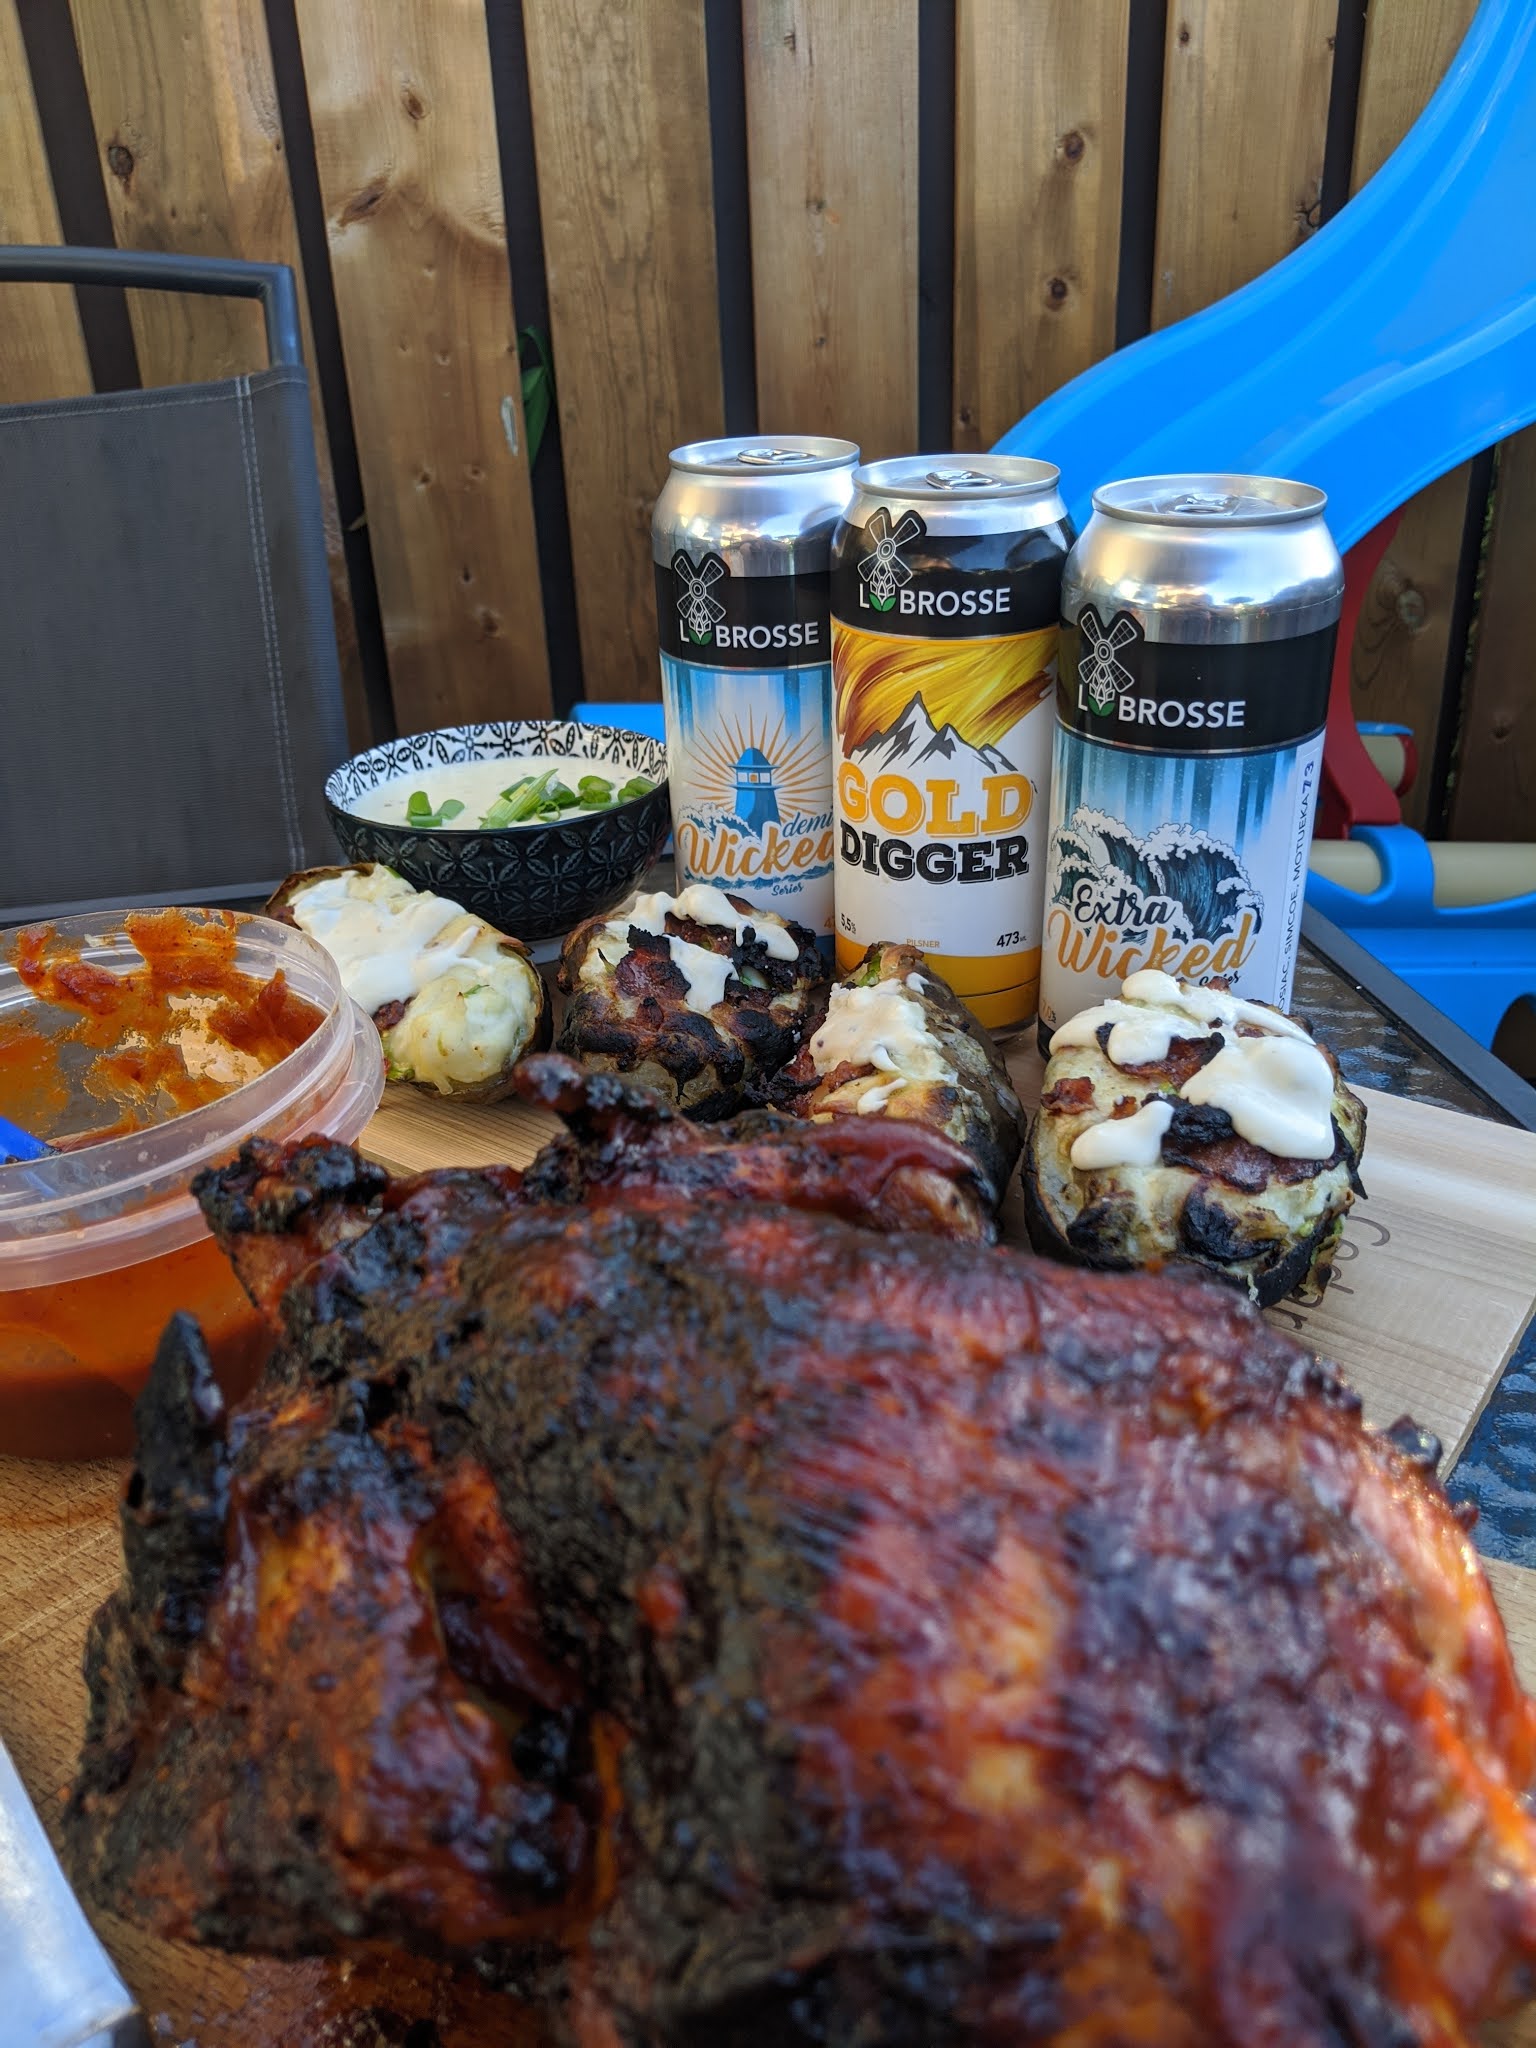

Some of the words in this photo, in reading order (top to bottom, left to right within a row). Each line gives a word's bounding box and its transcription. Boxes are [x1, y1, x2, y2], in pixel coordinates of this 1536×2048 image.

[838, 761, 1034, 838] GOLD
[840, 819, 1029, 884] DIGGER
[1292, 793, 1309, 882] MOTUEKA
[771, 882, 804, 897] Series
[1074, 884, 1176, 926] Extra
[906, 938, 940, 948] PILSNER
[996, 931, 1019, 947] 473
[1047, 913, 1256, 980] Wicked
